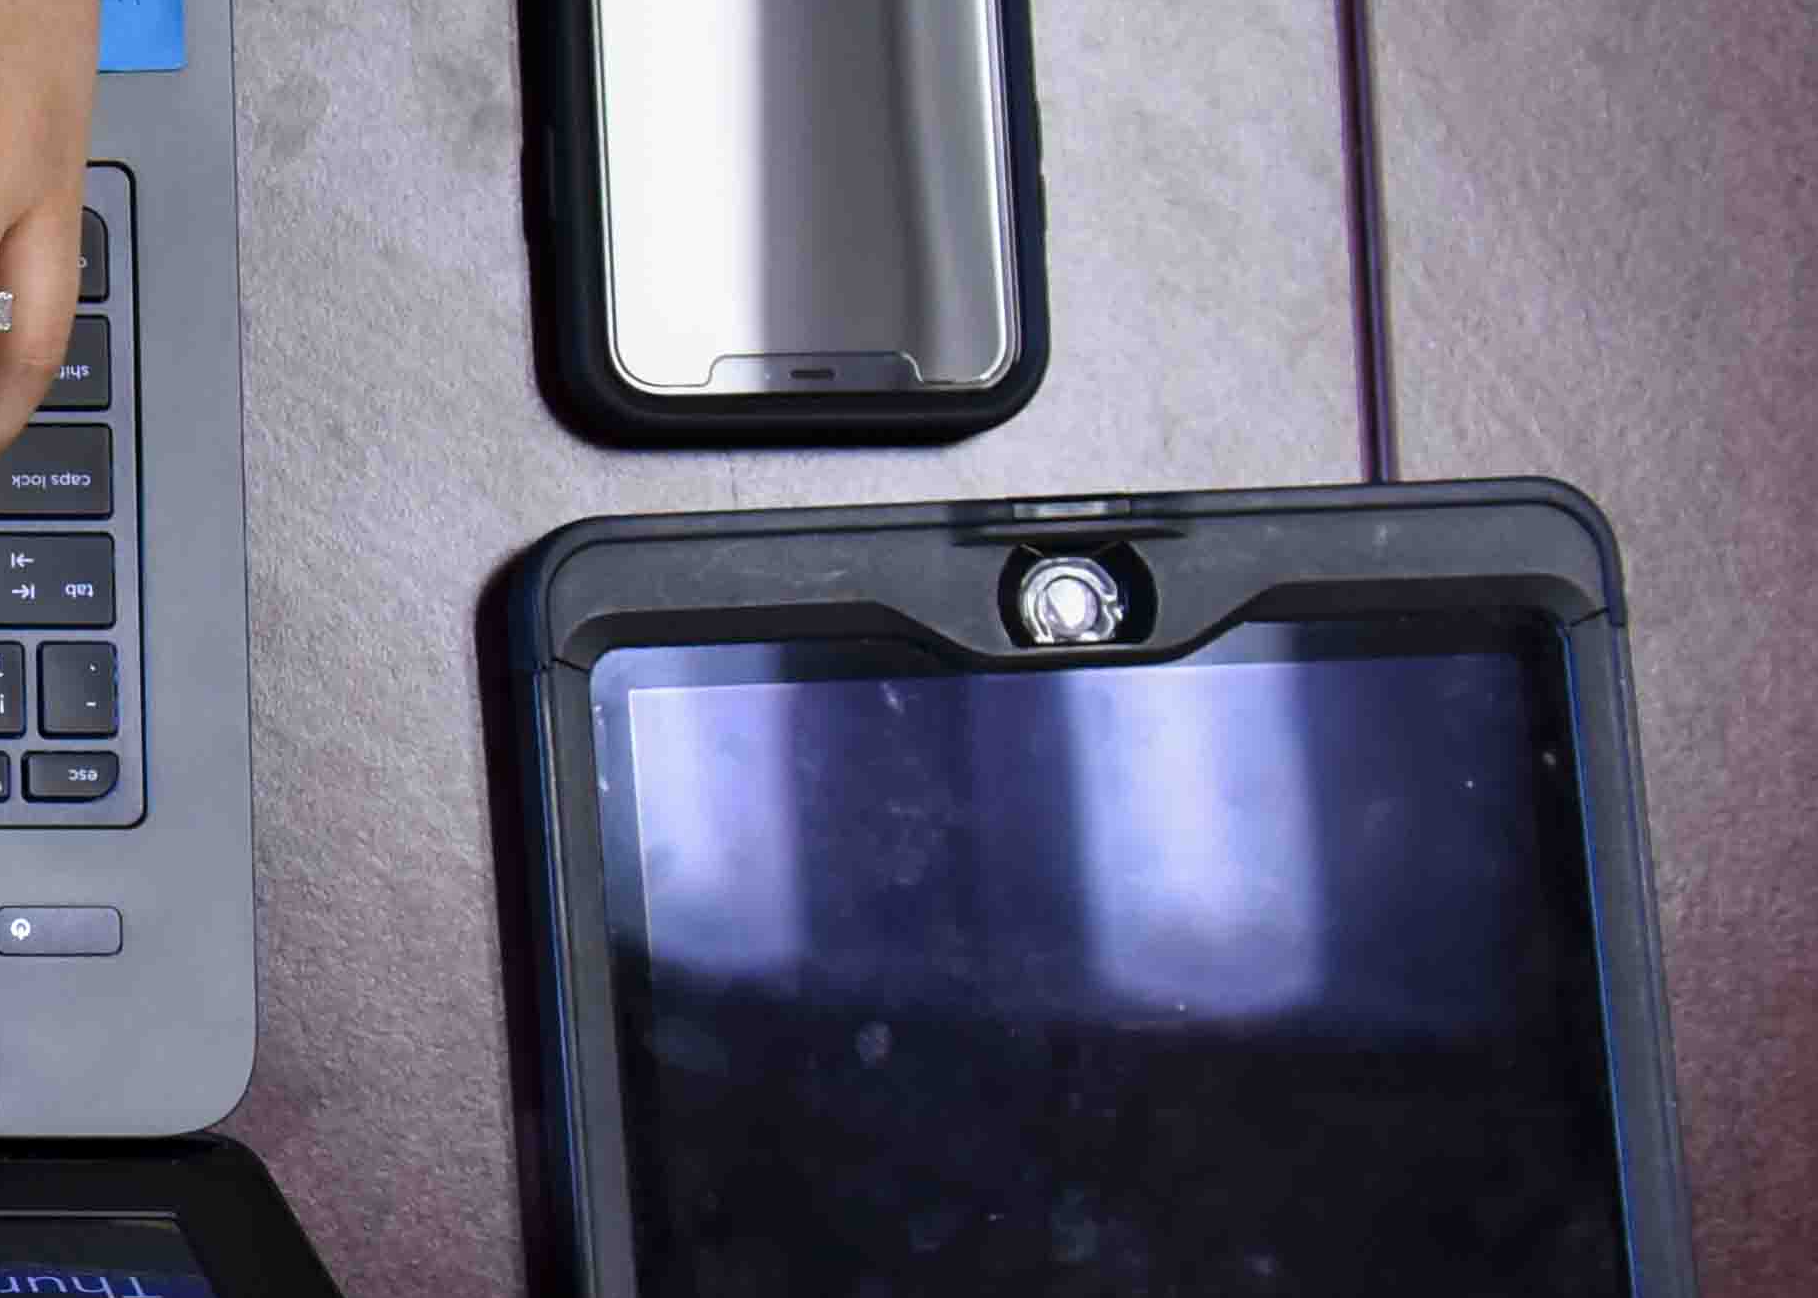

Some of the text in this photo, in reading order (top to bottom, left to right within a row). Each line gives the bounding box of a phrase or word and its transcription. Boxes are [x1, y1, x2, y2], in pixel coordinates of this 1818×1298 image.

[59, 364, 91, 381] shif
[11, 472, 91, 489] caps lock
[64, 583, 94, 598] tab
[68, 768, 98, 782] esc
